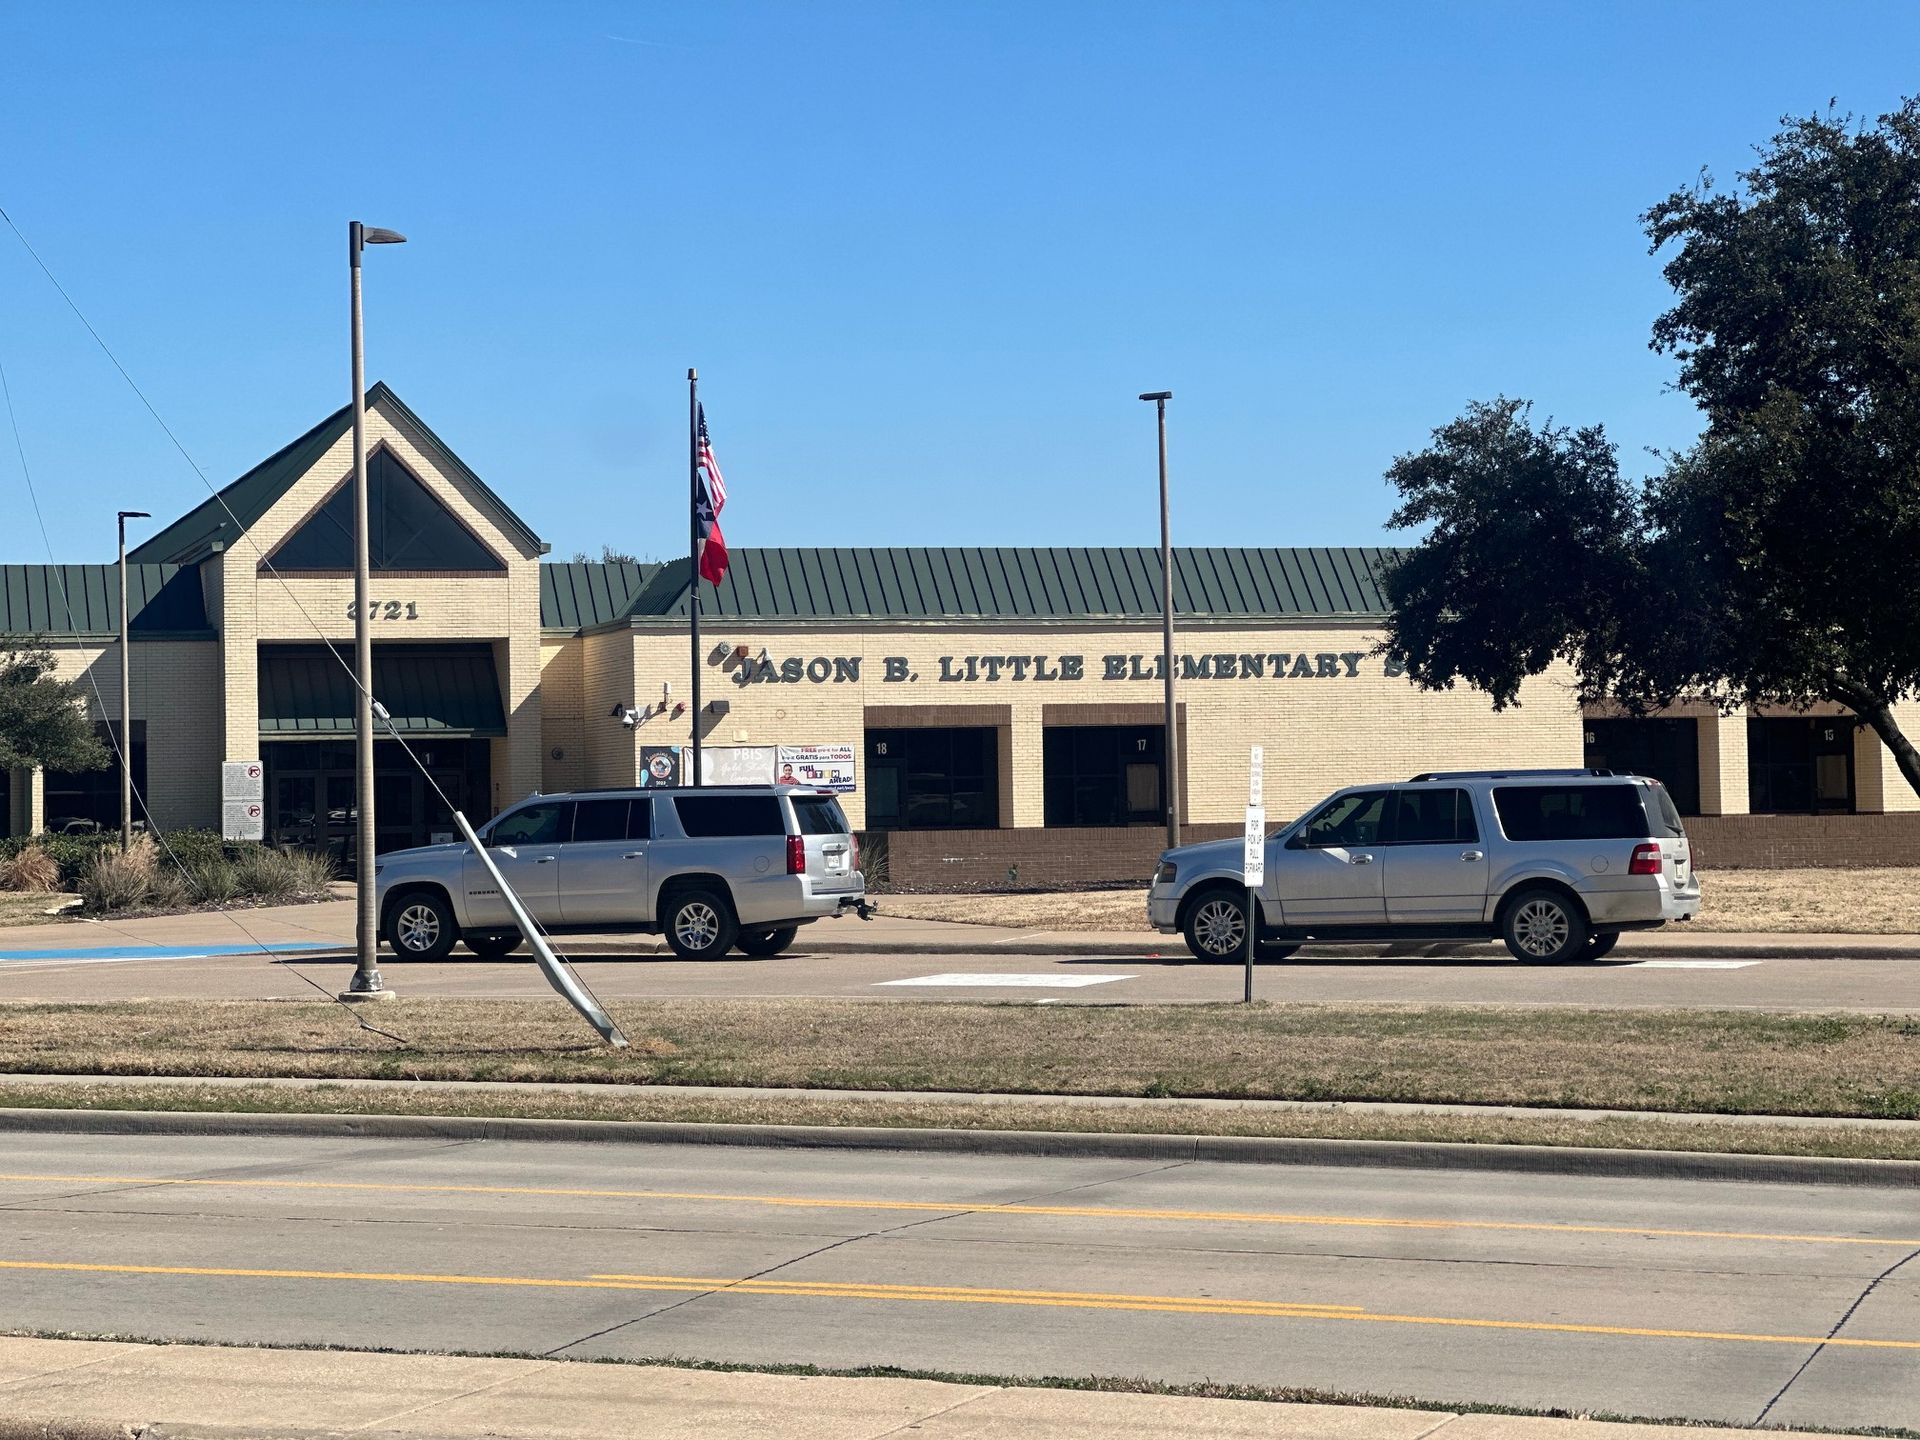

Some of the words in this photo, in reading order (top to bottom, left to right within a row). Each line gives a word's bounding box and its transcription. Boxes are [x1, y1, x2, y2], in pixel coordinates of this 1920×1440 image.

[731, 657, 862, 683] JASON
[882, 656, 919, 683] B.
[938, 655, 1084, 682] LITTLE
[1101, 653, 1366, 681] ELEMENTARY
[1584, 731, 1595, 744] 16
[1824, 729, 1834, 741] 15
[876, 742, 888, 755] 18
[1136, 739, 1147, 751] 17
[734, 748, 763, 760] PBIS
[799, 764, 815, 772] FULL
